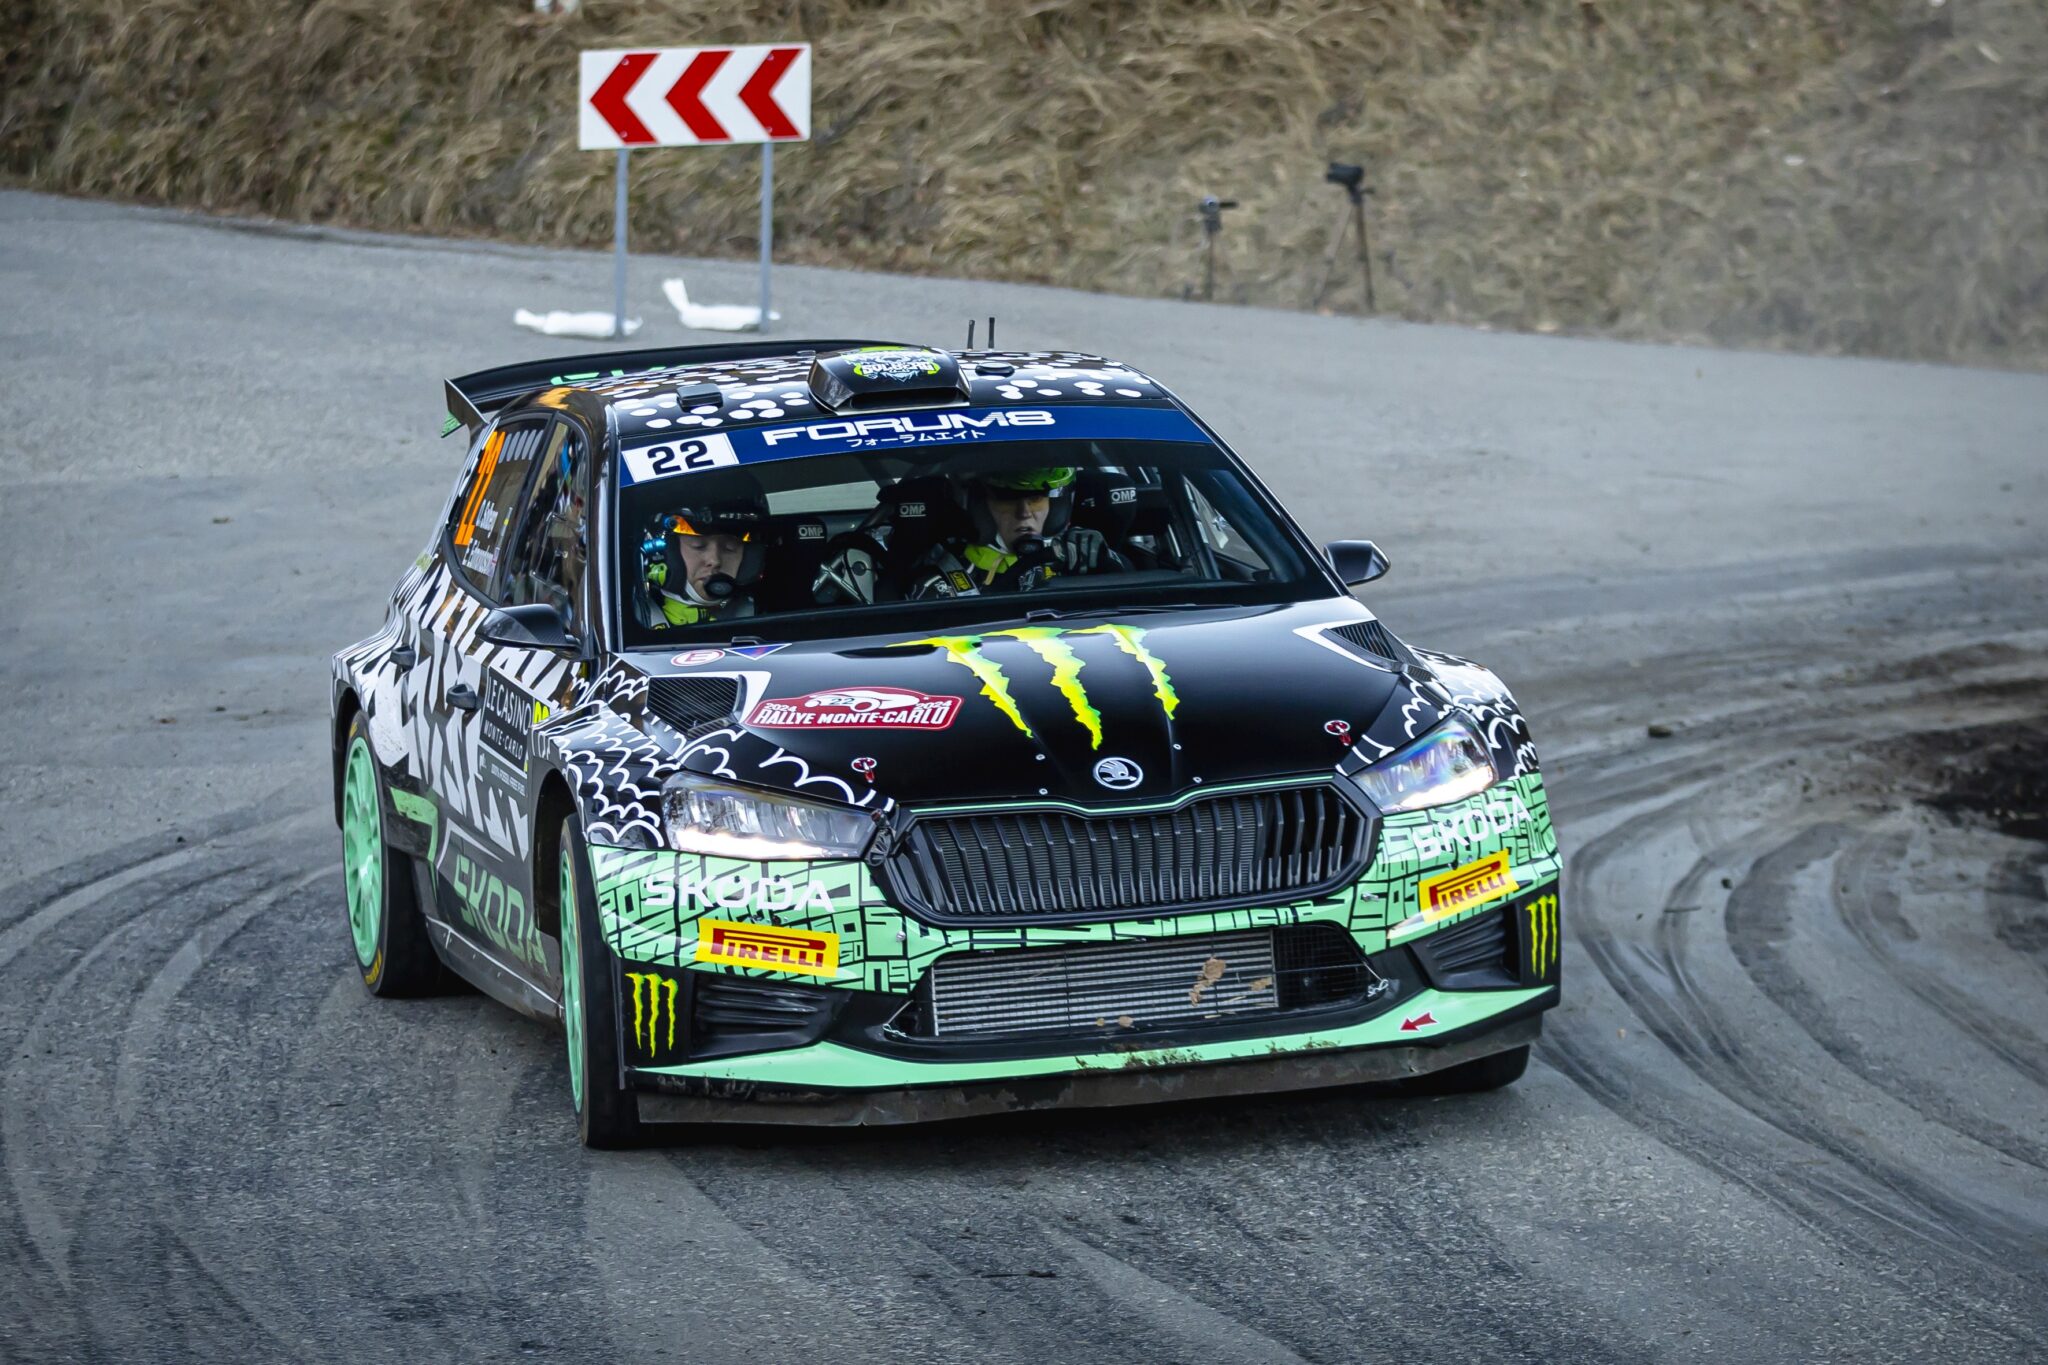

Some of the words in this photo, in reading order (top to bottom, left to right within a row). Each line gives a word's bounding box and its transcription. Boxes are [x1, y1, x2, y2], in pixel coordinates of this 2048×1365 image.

[761, 410, 1056, 446] FORUM8
[846, 429, 986, 448] フォーラムエイト
[647, 440, 715, 475] 22
[1111, 489, 1137, 502] OMP
[899, 504, 926, 516] OMP
[798, 527, 824, 537] OMP
[486, 677, 497, 712] LE
[496, 685, 532, 736] CASINO
[765, 702, 798, 713] 2024
[915, 699, 953, 710] 2024
[753, 709, 816, 725] RALLYE
[816, 706, 951, 725] MONTE-CARLO
[1429, 859, 1506, 912] PIRELLI
[710, 927, 827, 968] PIRELLI
